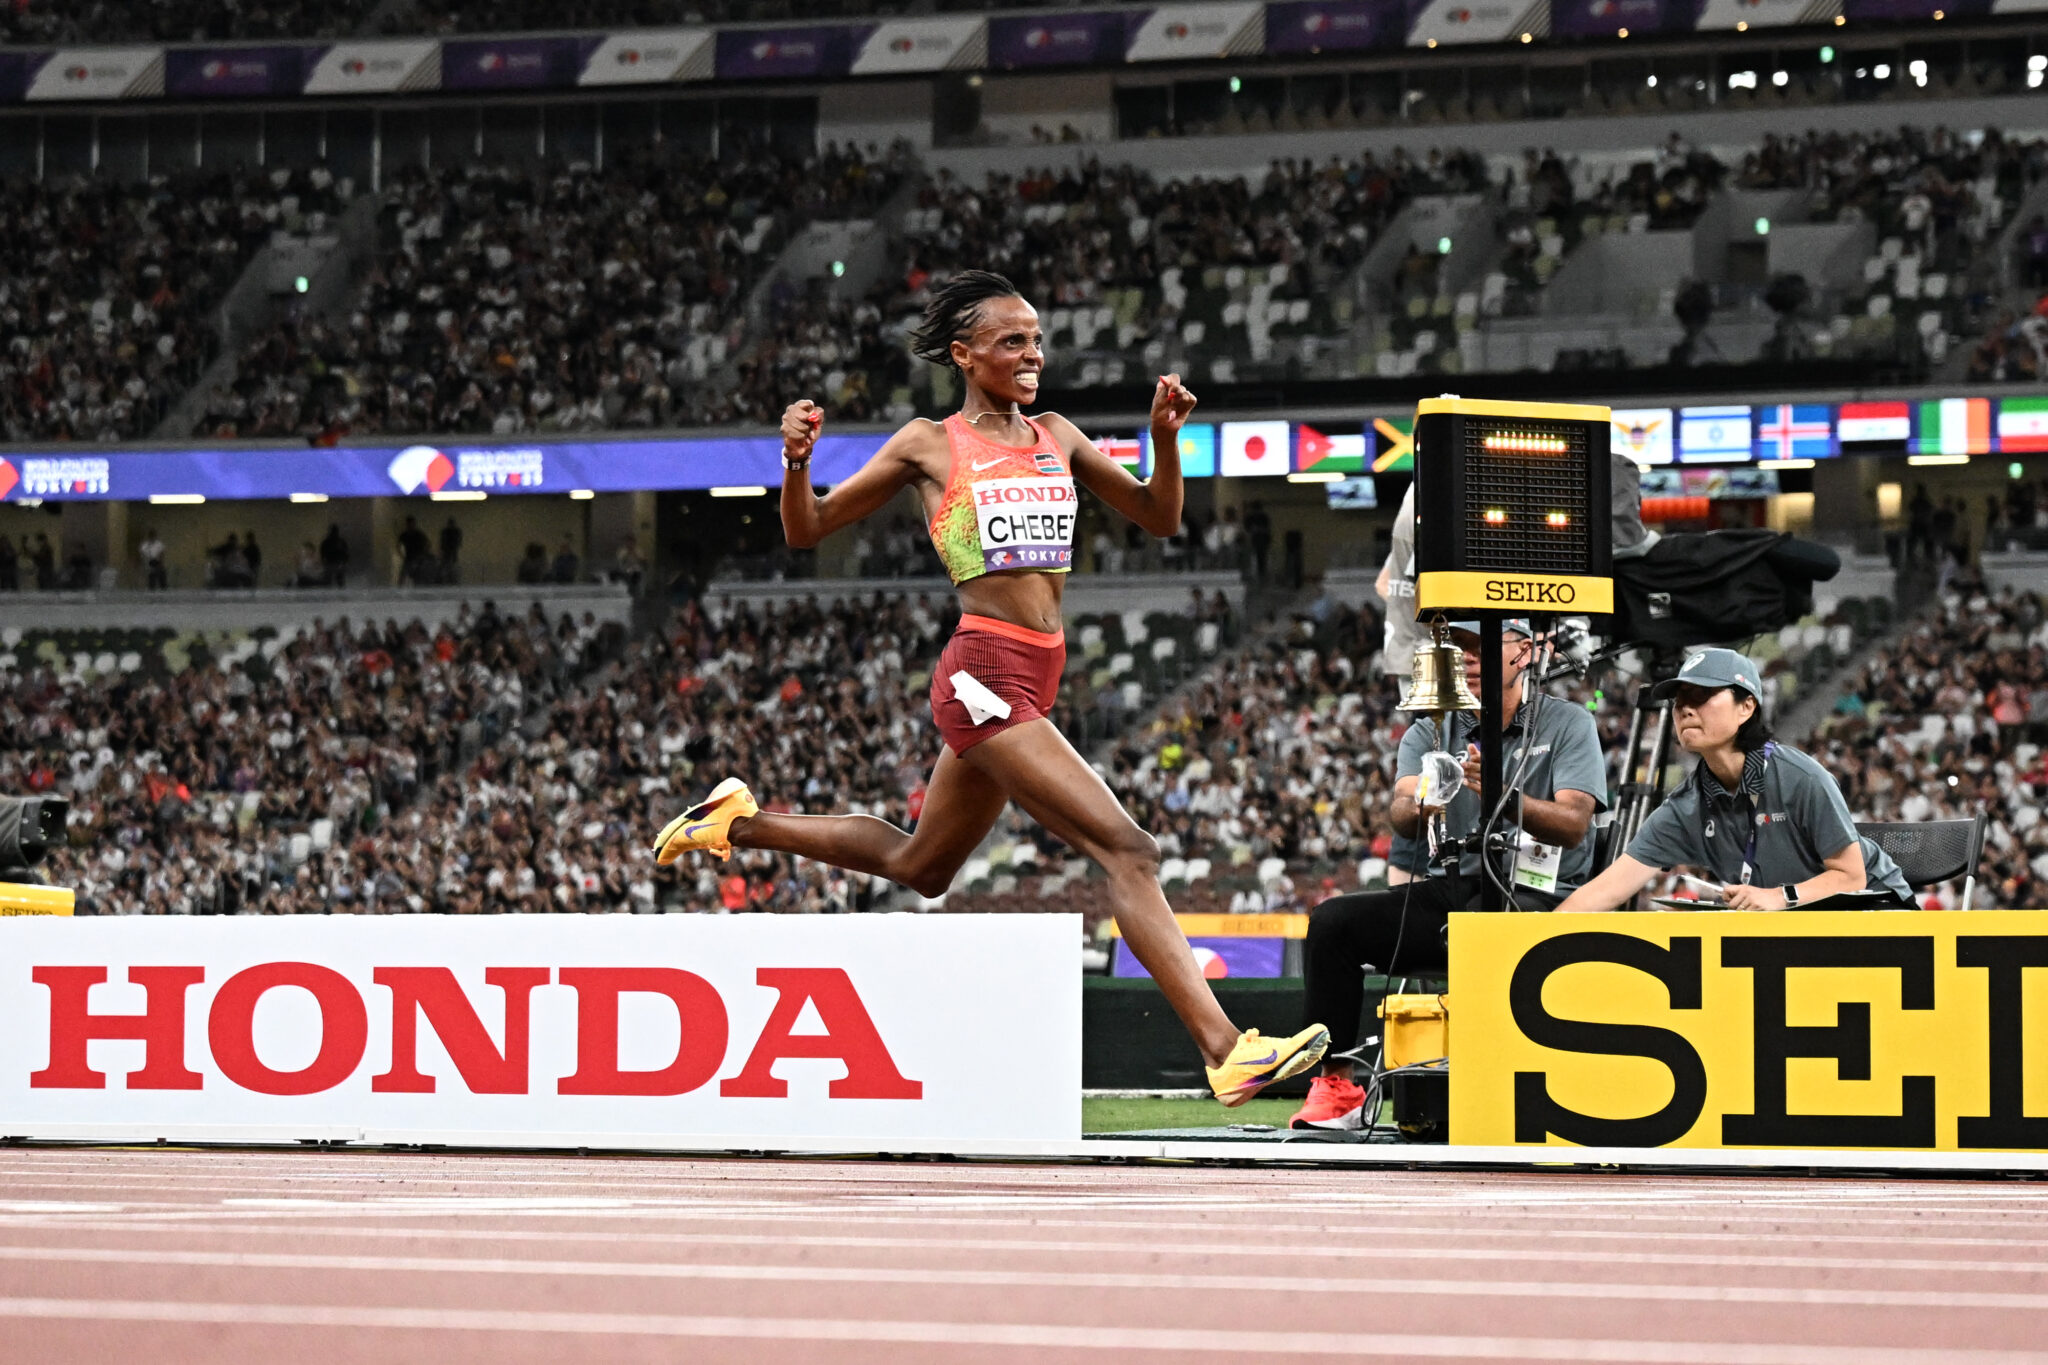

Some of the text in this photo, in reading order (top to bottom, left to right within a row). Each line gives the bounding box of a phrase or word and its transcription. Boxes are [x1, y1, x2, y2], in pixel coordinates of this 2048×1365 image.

[977, 486, 1076, 506] HONDA
[1486, 580, 1576, 604] SEIKO
[30, 961, 923, 1100] HONDA
[1509, 931, 2048, 1149] SEI
